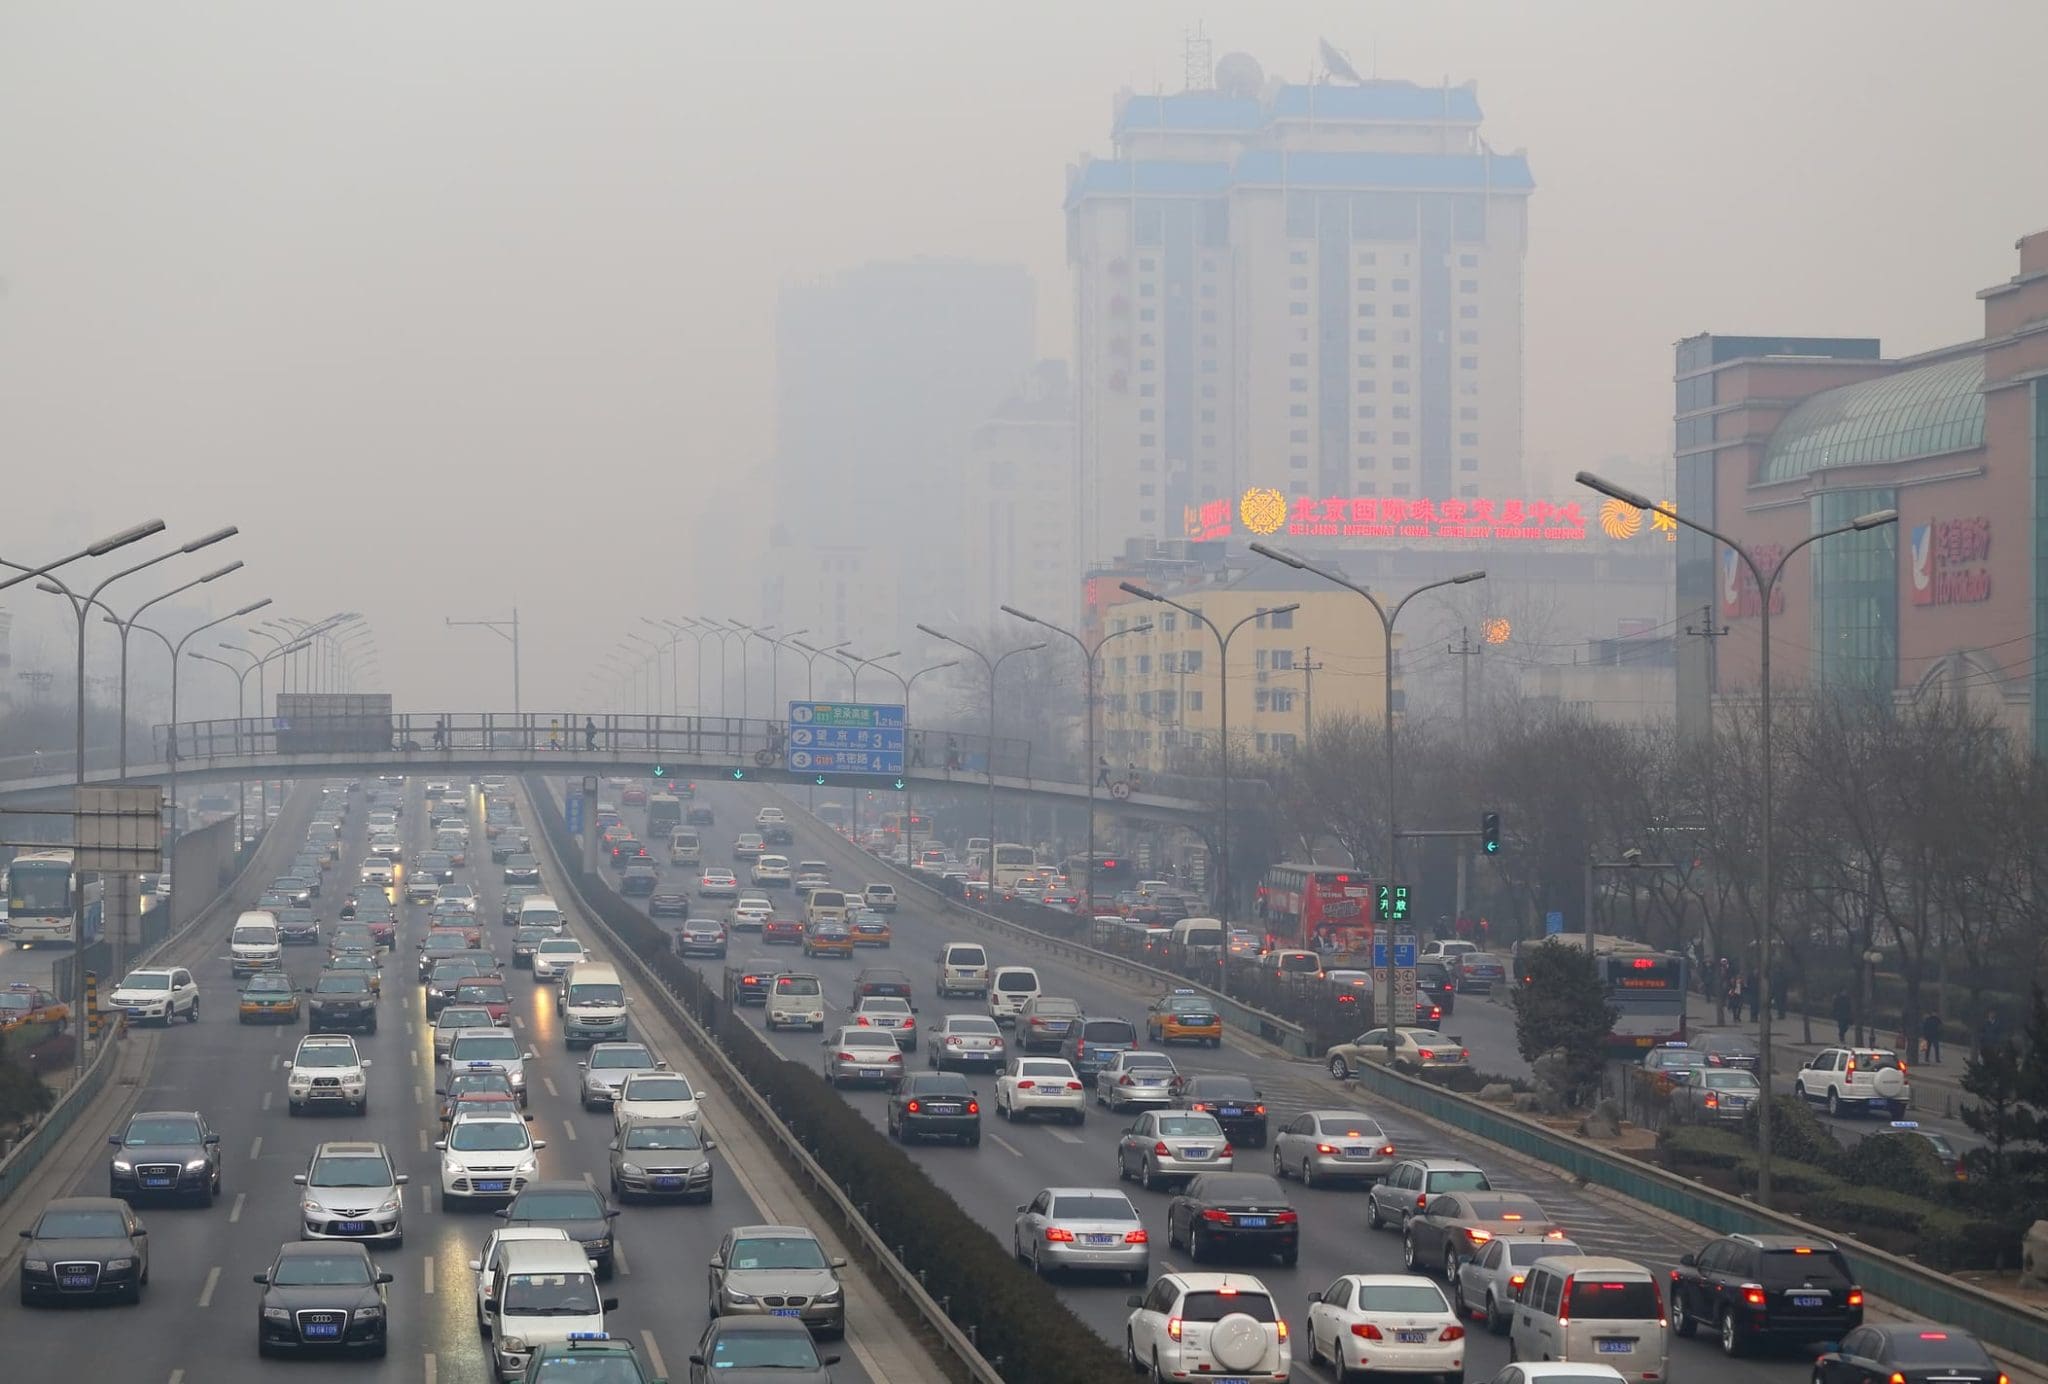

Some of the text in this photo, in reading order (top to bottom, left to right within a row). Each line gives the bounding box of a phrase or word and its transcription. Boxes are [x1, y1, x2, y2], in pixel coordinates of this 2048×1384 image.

[1289, 496, 1587, 526] 北京国际珠宝交易中心
[1290, 523, 1337, 536] BEIJING
[1495, 527, 1541, 538] TRADING
[1544, 528, 1585, 540] CENTER
